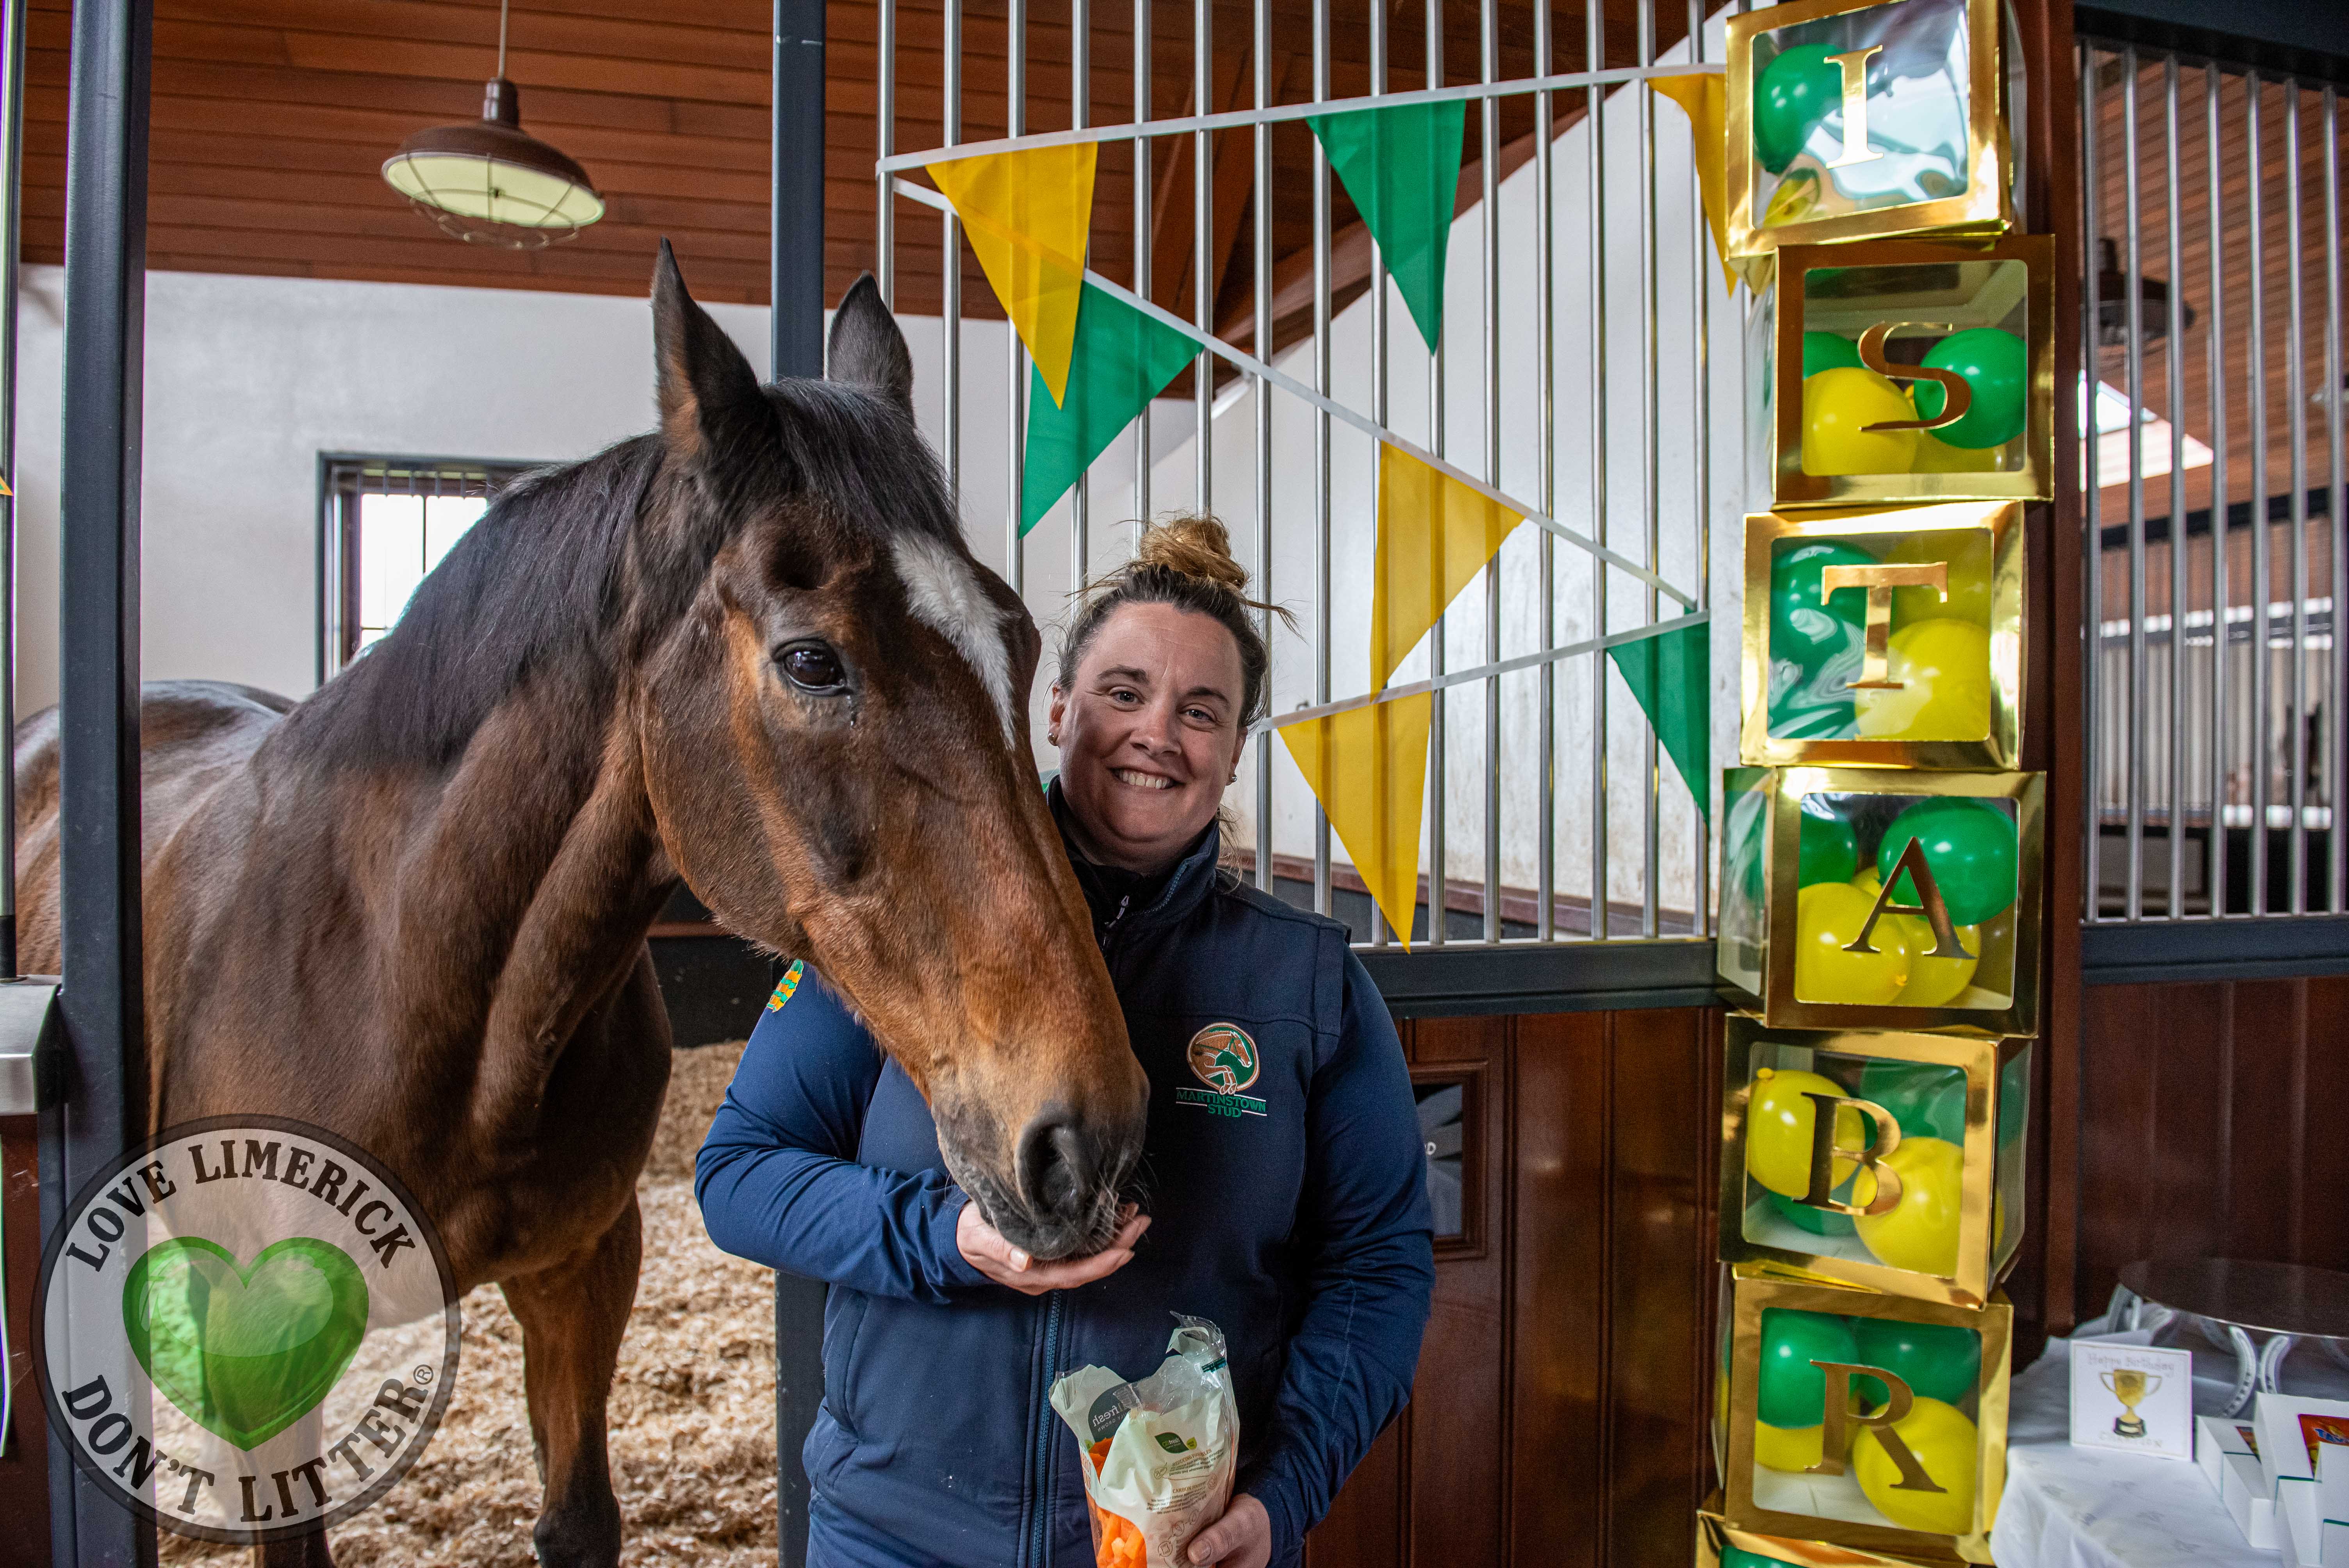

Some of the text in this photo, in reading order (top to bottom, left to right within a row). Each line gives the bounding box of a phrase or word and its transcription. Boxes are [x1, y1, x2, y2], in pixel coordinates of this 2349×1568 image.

[1823, 45, 1884, 169] I
[1858, 320, 1972, 432] S
[1821, 561, 1948, 689] T
[1842, 836, 1976, 959] A
[1176, 1090, 1266, 1112] MARTINSTOWN
[1208, 1103, 1242, 1117] STUD
[1793, 1092, 1903, 1216] B
[1804, 1360, 1948, 1493] R
